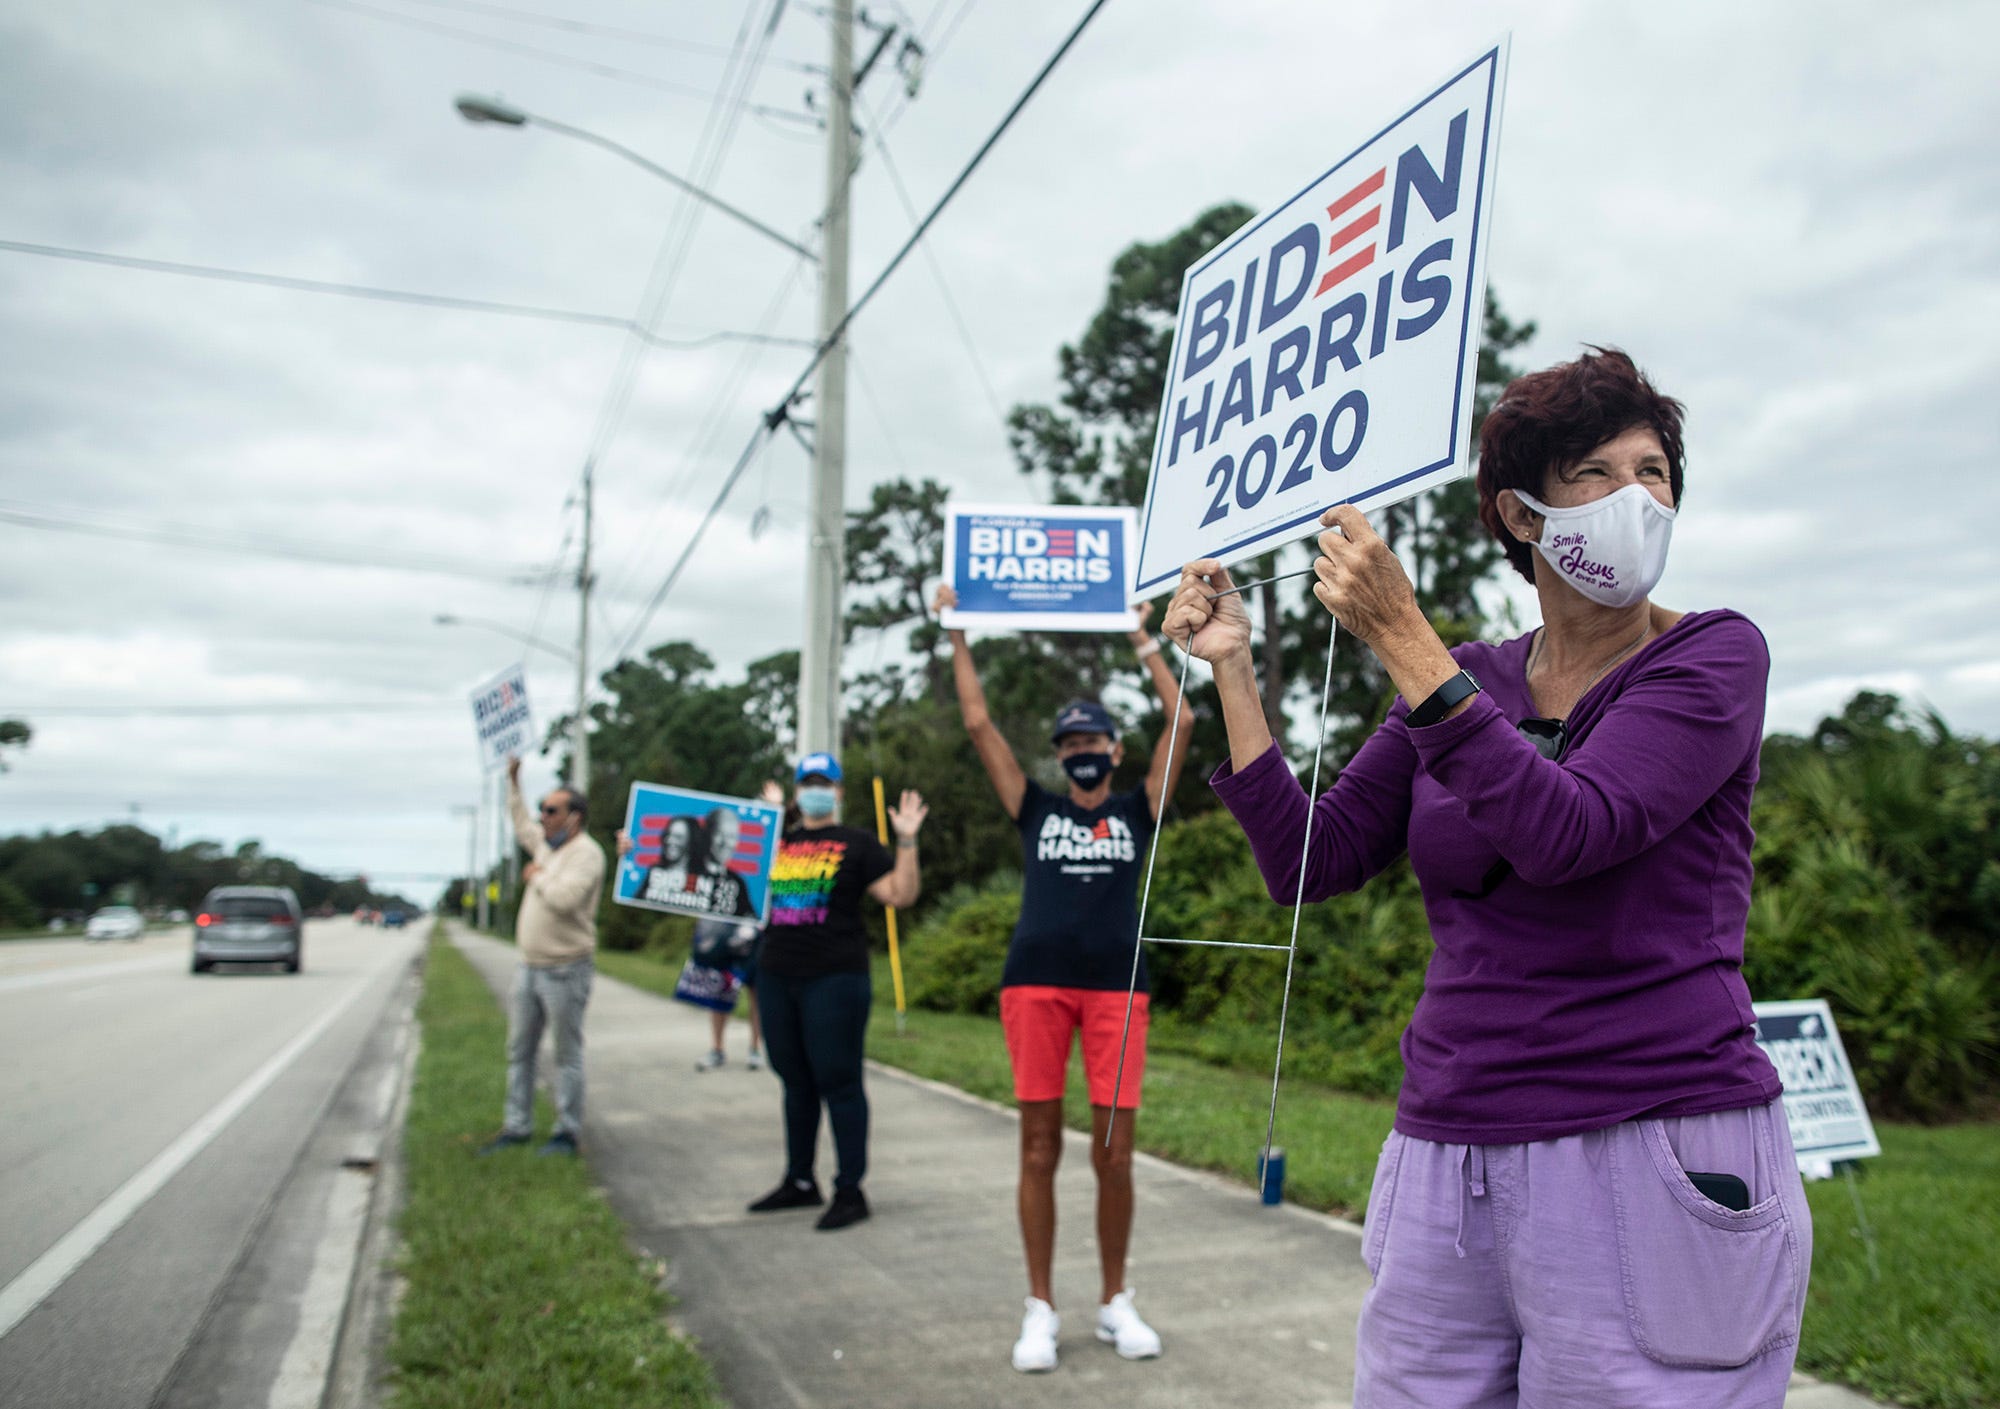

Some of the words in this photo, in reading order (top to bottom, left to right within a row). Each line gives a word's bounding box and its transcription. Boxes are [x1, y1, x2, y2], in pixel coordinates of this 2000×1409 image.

[1183, 108, 1468, 382] BIDEN
[1168, 238, 1454, 468] HARRIS
[1199, 389, 1369, 529] 2020
[969, 527, 1110, 558] BIDEN
[1552, 532, 1588, 549] Smile,
[968, 556, 1112, 583] HARRIS
[1559, 546, 1616, 581] Jesus
[1575, 572, 1597, 585] loves
[1599, 580, 1620, 590] you!
[1039, 813, 1133, 846] BIDEN
[1037, 838, 1136, 862] HARRIS
